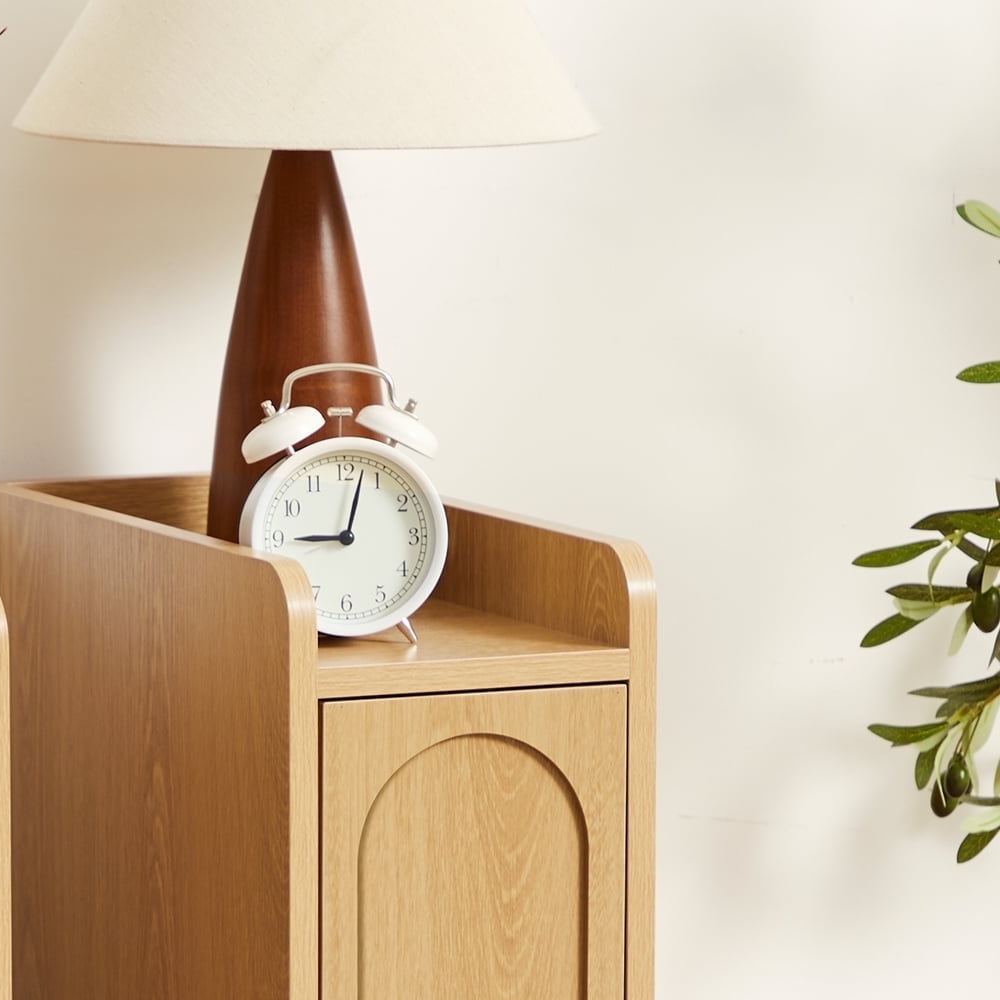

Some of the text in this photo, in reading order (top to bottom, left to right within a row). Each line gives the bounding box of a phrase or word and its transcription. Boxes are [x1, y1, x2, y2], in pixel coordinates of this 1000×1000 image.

[336, 463, 355, 481] 12
[374, 472, 380, 490] 1
[306, 475, 321, 493] 11
[284, 499, 301, 517] 10
[396, 495, 408, 513] 2
[272, 530, 285, 548] 9
[408, 527, 420, 546] 3
[396, 560, 409, 577] 4
[340, 594, 353, 612] 6
[375, 585, 386, 603] 5
